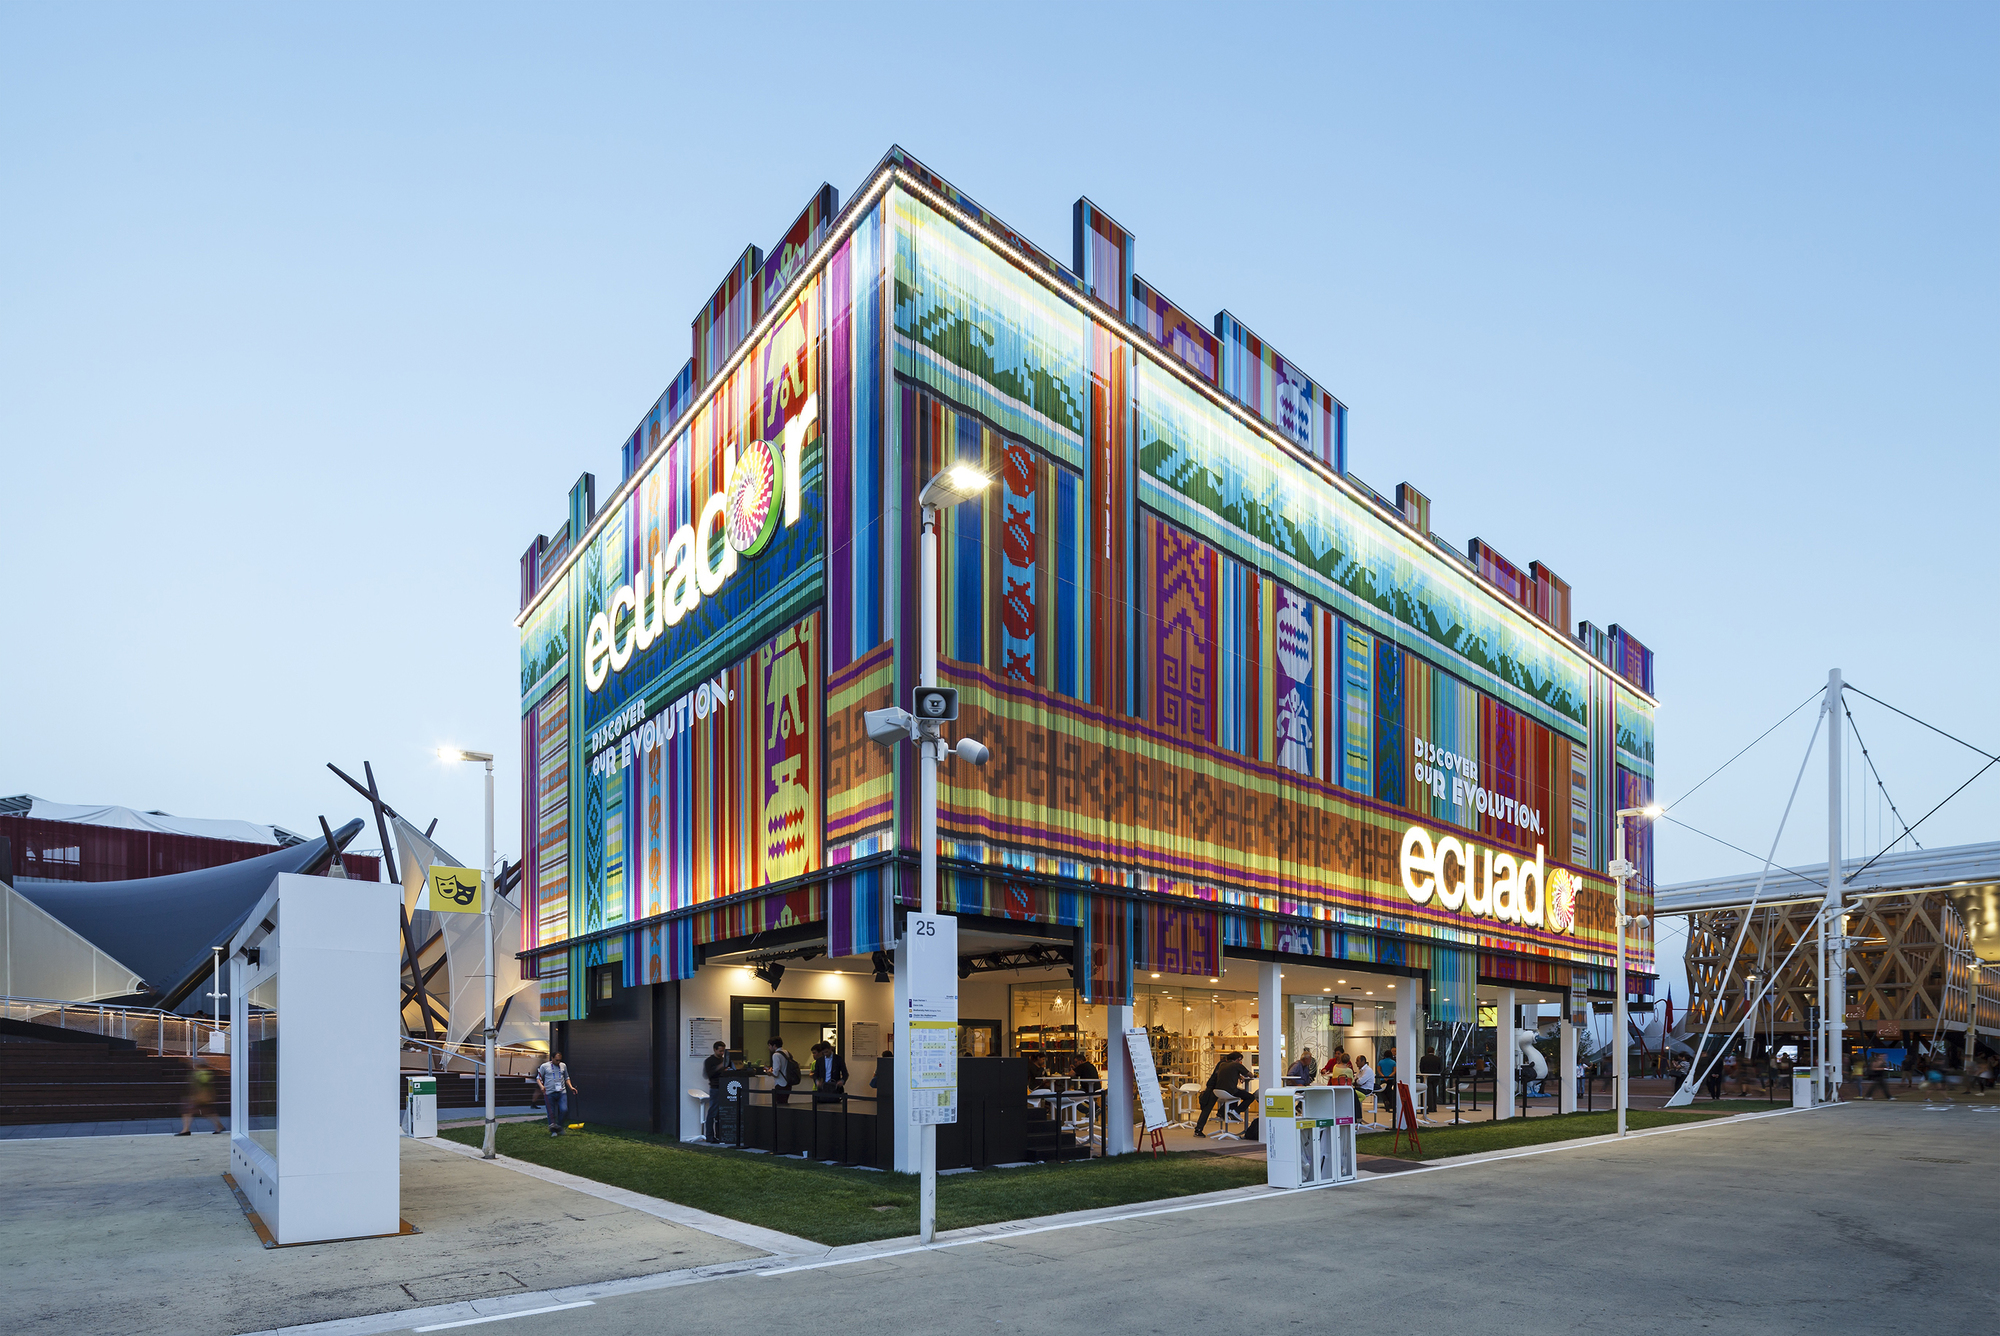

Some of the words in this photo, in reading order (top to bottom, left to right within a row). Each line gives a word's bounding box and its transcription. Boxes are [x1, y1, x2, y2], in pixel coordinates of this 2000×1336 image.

[584, 392, 819, 695] ecuador
[592, 745, 617, 779] OUR
[621, 668, 735, 769] EVOLUTION.
[592, 698, 646, 754] DISCOVER
[1414, 736, 1478, 782] DISCOVER
[1414, 762, 1446, 800] OUR
[1452, 776, 1545, 837] EVOLUTION.
[1400, 826, 1583, 937] ecuador
[916, 920, 936, 937] 25
